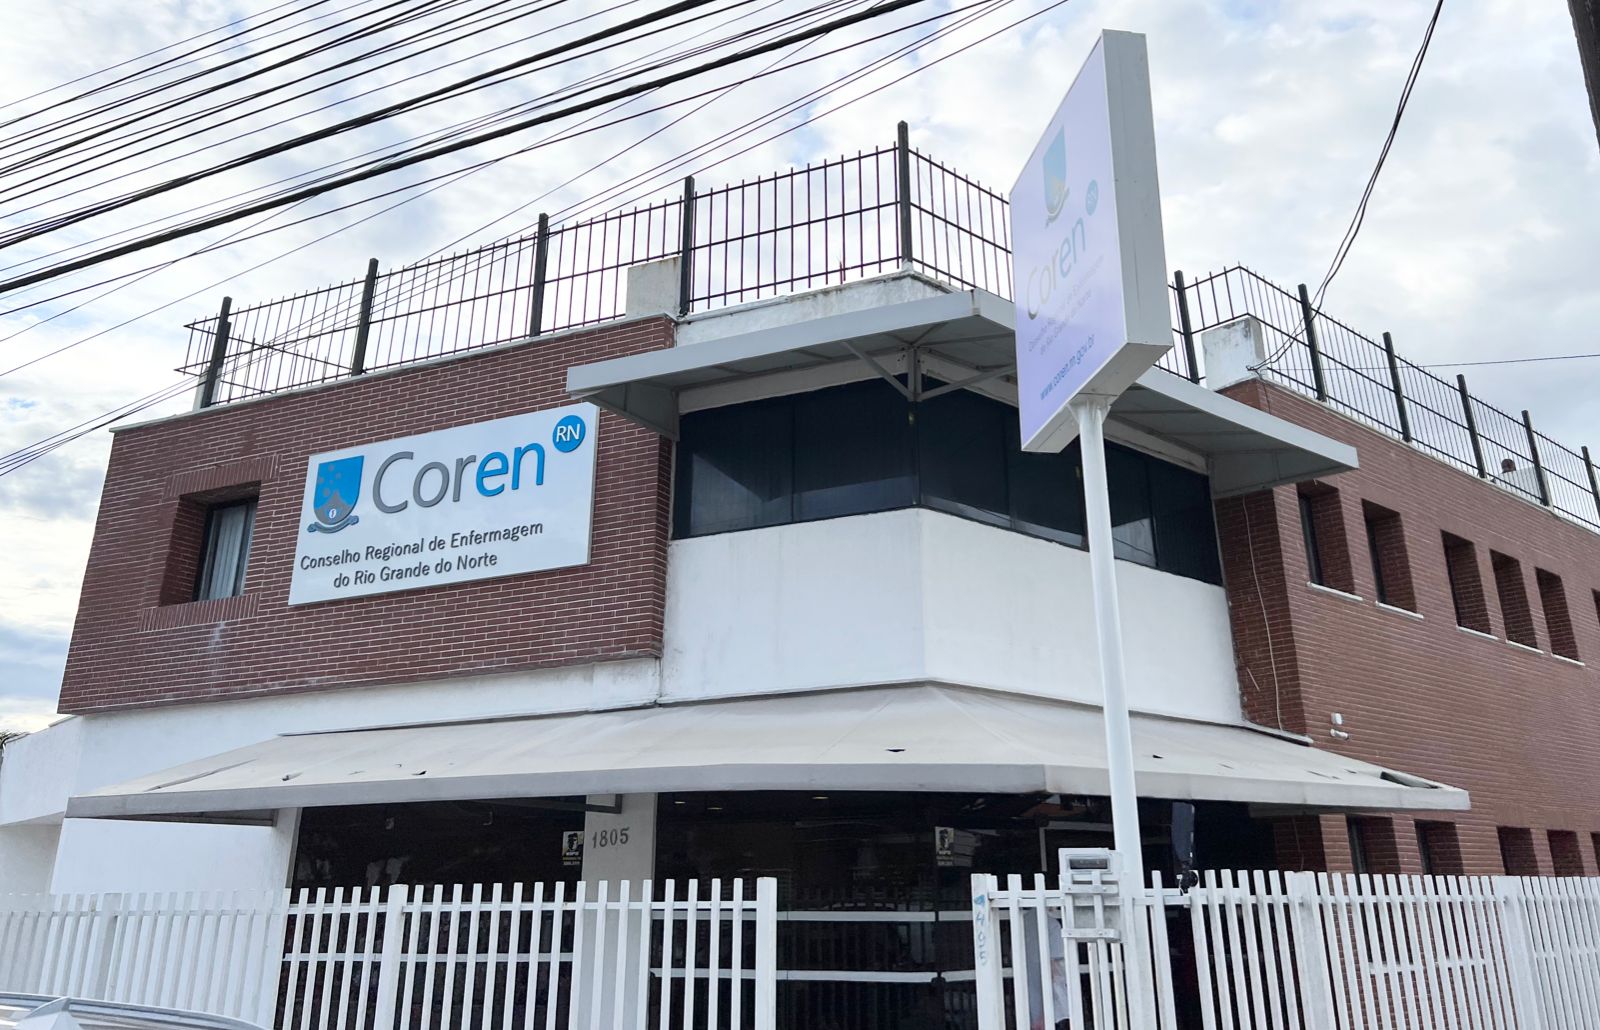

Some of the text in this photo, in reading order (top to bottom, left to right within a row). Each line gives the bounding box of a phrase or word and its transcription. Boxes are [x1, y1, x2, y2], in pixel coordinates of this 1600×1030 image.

[1026, 217, 1087, 321] Coren
[555, 423, 581, 442] RN
[372, 442, 546, 514] Coren
[300, 522, 544, 571] Conselho Regional de Enfermagem
[333, 552, 498, 588] do Rio Grande do Norte
[592, 826, 630, 849] 1805
